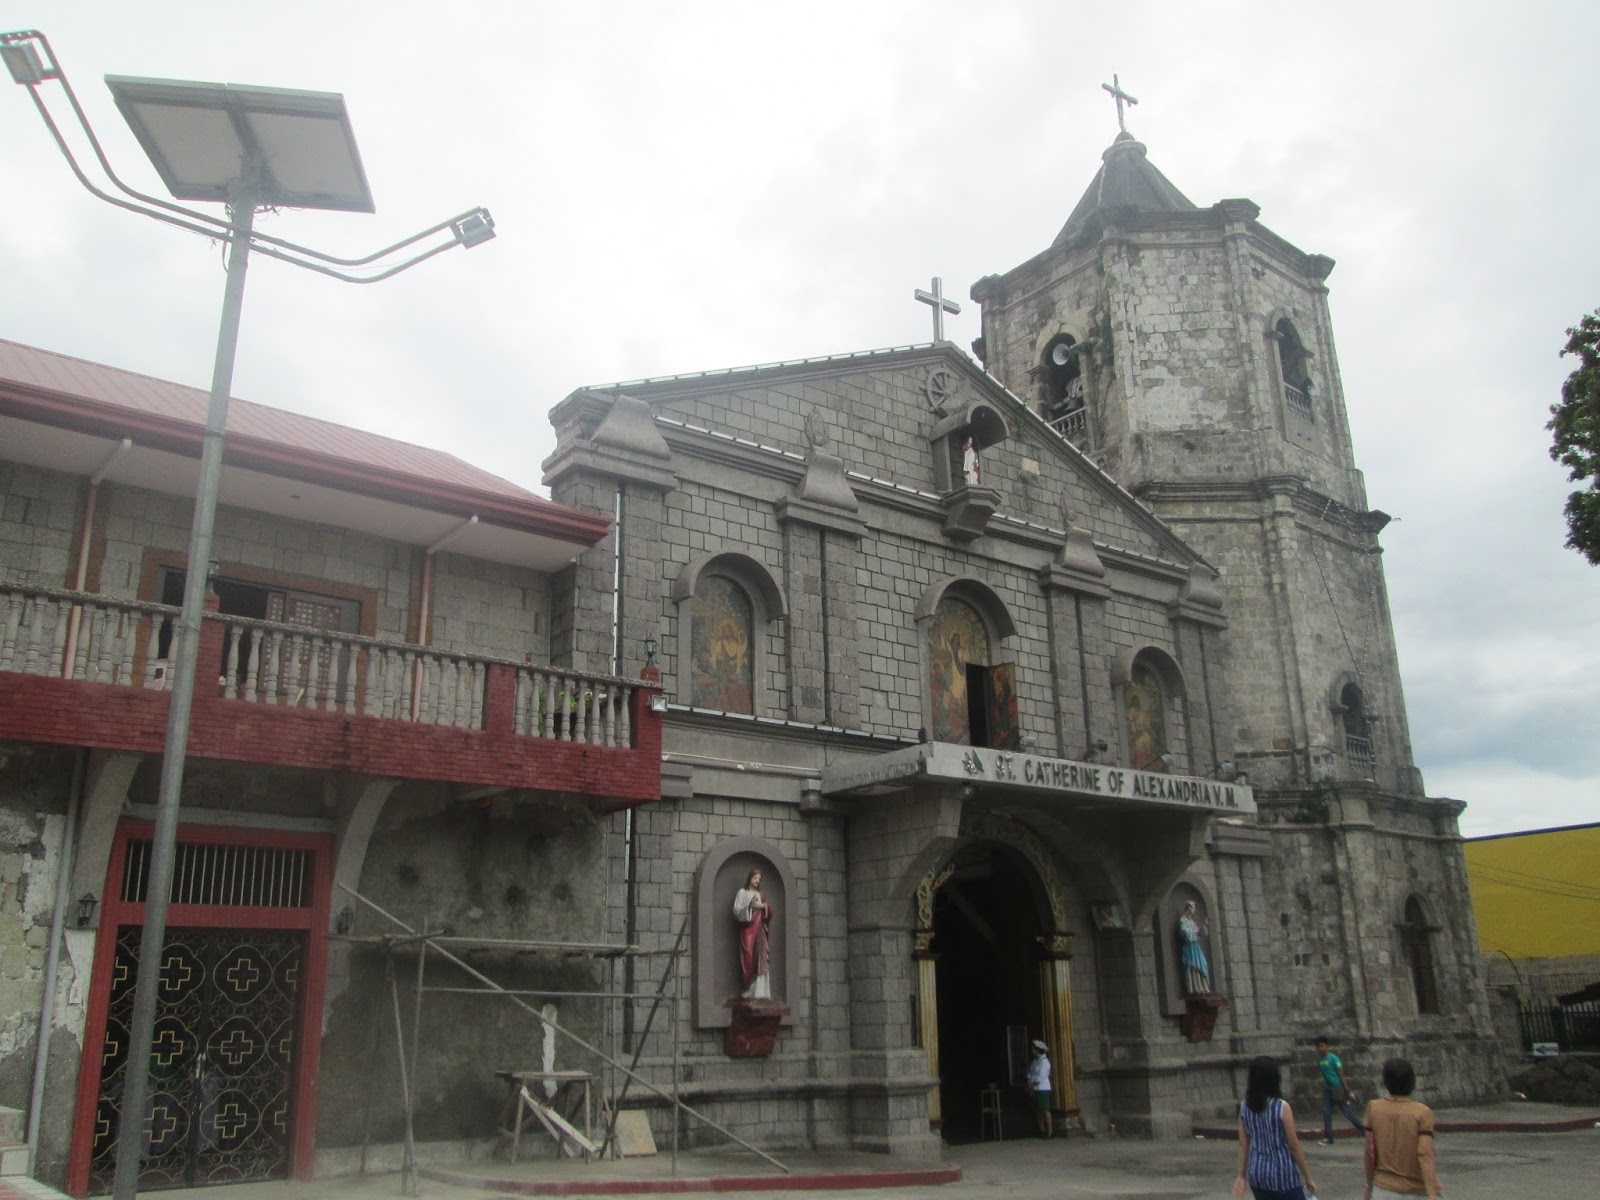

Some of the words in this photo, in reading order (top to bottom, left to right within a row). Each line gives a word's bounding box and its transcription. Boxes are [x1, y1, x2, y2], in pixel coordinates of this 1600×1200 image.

[995, 754, 1017, 781] ST.
[1024, 758, 1101, 791] CATHERINE
[1108, 770, 1124, 794] OF
[1132, 773, 1212, 806] ALEXANDRIA
